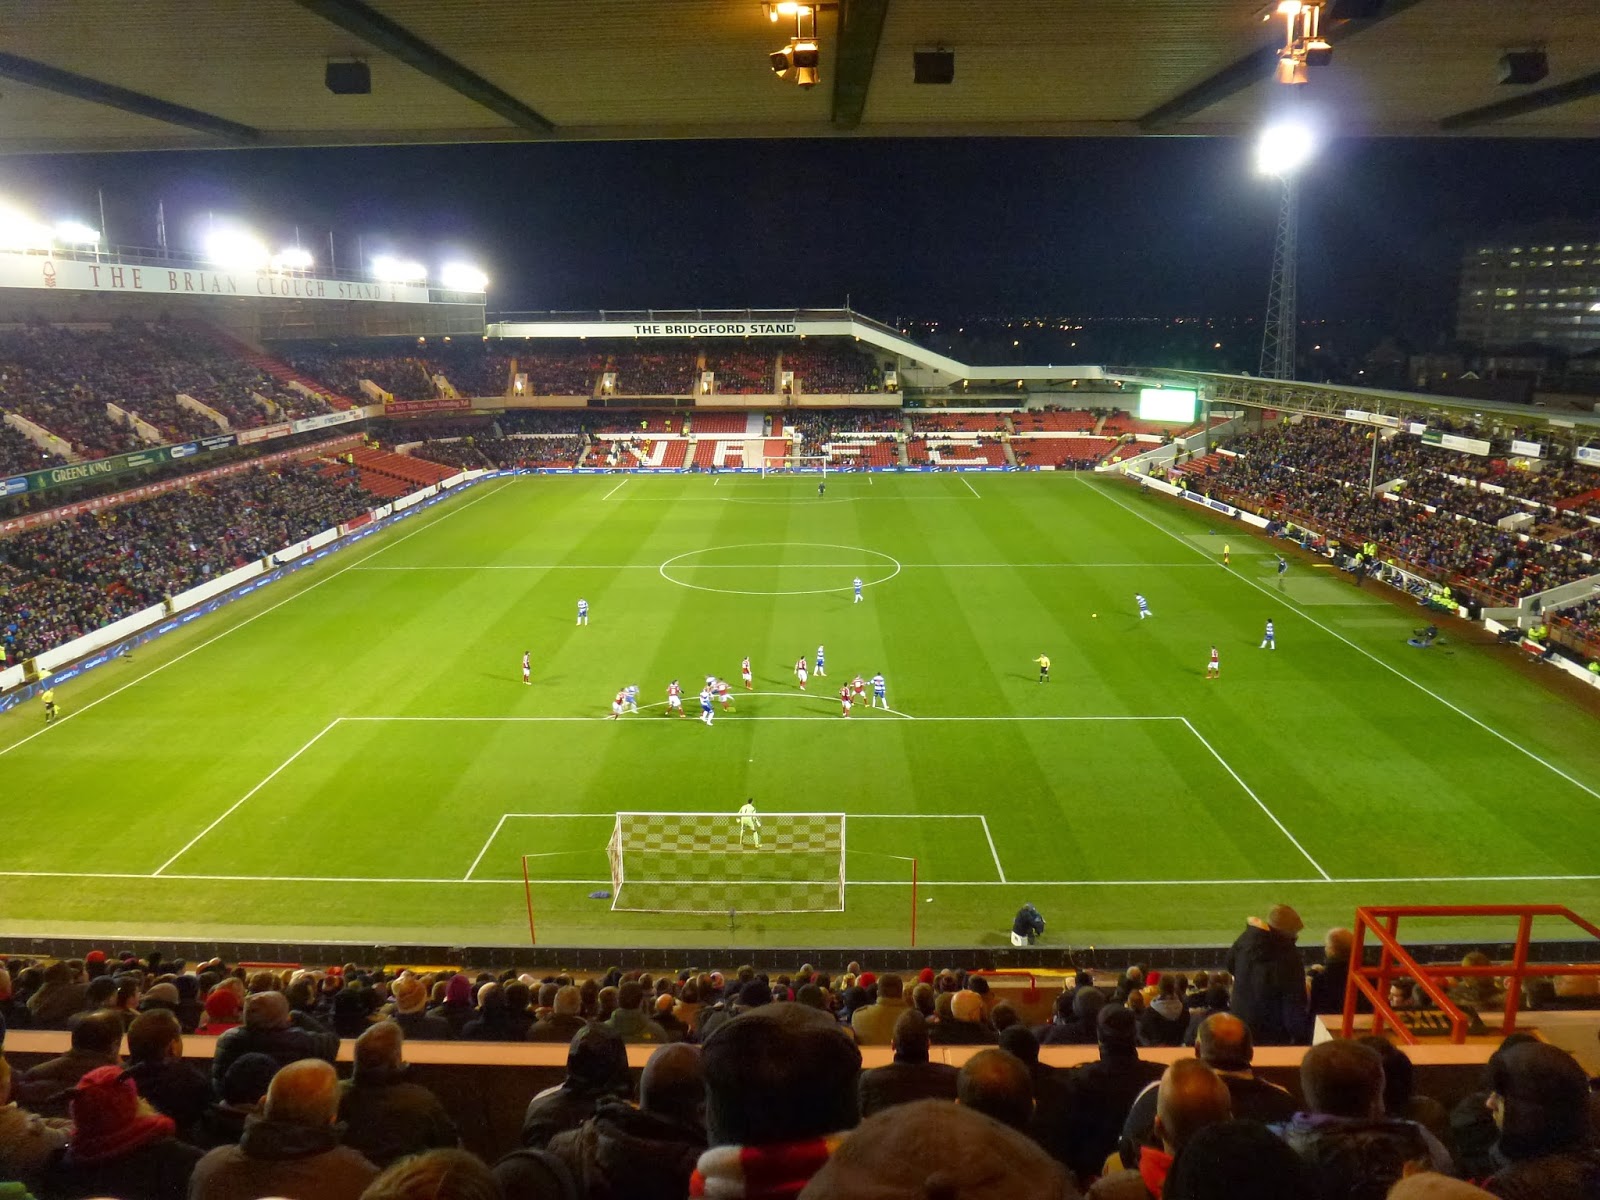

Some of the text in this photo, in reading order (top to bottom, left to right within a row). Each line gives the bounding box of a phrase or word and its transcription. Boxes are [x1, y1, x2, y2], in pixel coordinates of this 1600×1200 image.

[89, 265, 381, 299] THE BRIAN CLOUGH STAND
[634, 323, 797, 334] THE BRIDGFORD STAND
[51, 465, 89, 483] GREENE
[88, 460, 112, 476] KING
